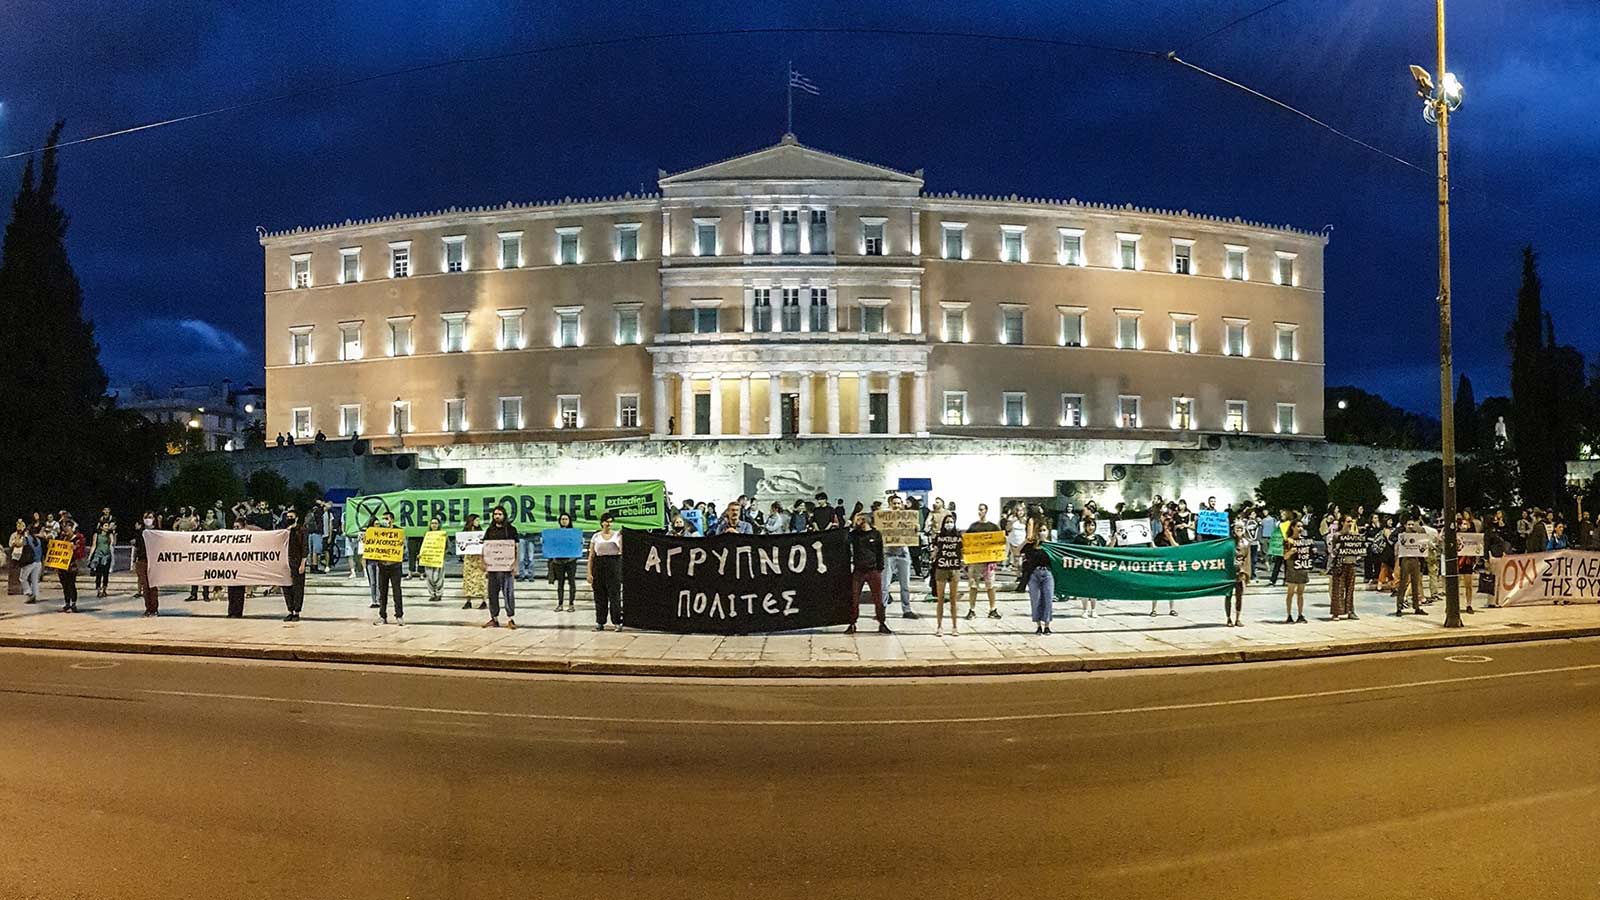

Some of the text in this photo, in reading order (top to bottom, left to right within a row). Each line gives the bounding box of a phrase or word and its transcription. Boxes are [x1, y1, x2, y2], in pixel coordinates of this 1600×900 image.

[606, 495, 646, 507] extinction
[400, 493, 597, 527] REBEL FOR LIFE
[618, 503, 656, 516] rebellion
[191, 534, 252, 544] ΚΑΤΑΡΓΗΣΗ
[157, 551, 281, 562] ΑΝΤΙ-ΠΕΡΙΒΑΛΛΟΝΤΙΚΟΥ
[644, 540, 828, 579] ΑΓΡΥΠΝΟΙ
[942, 550, 957, 558] FOR
[938, 557, 960, 568] SALE
[1062, 556, 1226, 572] ΠΡΟΤΕΡΑΙΟΤΗΤΑ Η ΦΥΣΗ
[1293, 559, 1313, 570] SALE
[203, 569, 238, 580] ΝΟΜΟΥ
[1502, 556, 1600, 592] ΟΧΙ ΣΤΗ ΛΕ
[1541, 577, 1573, 597] ΤΗΣ
